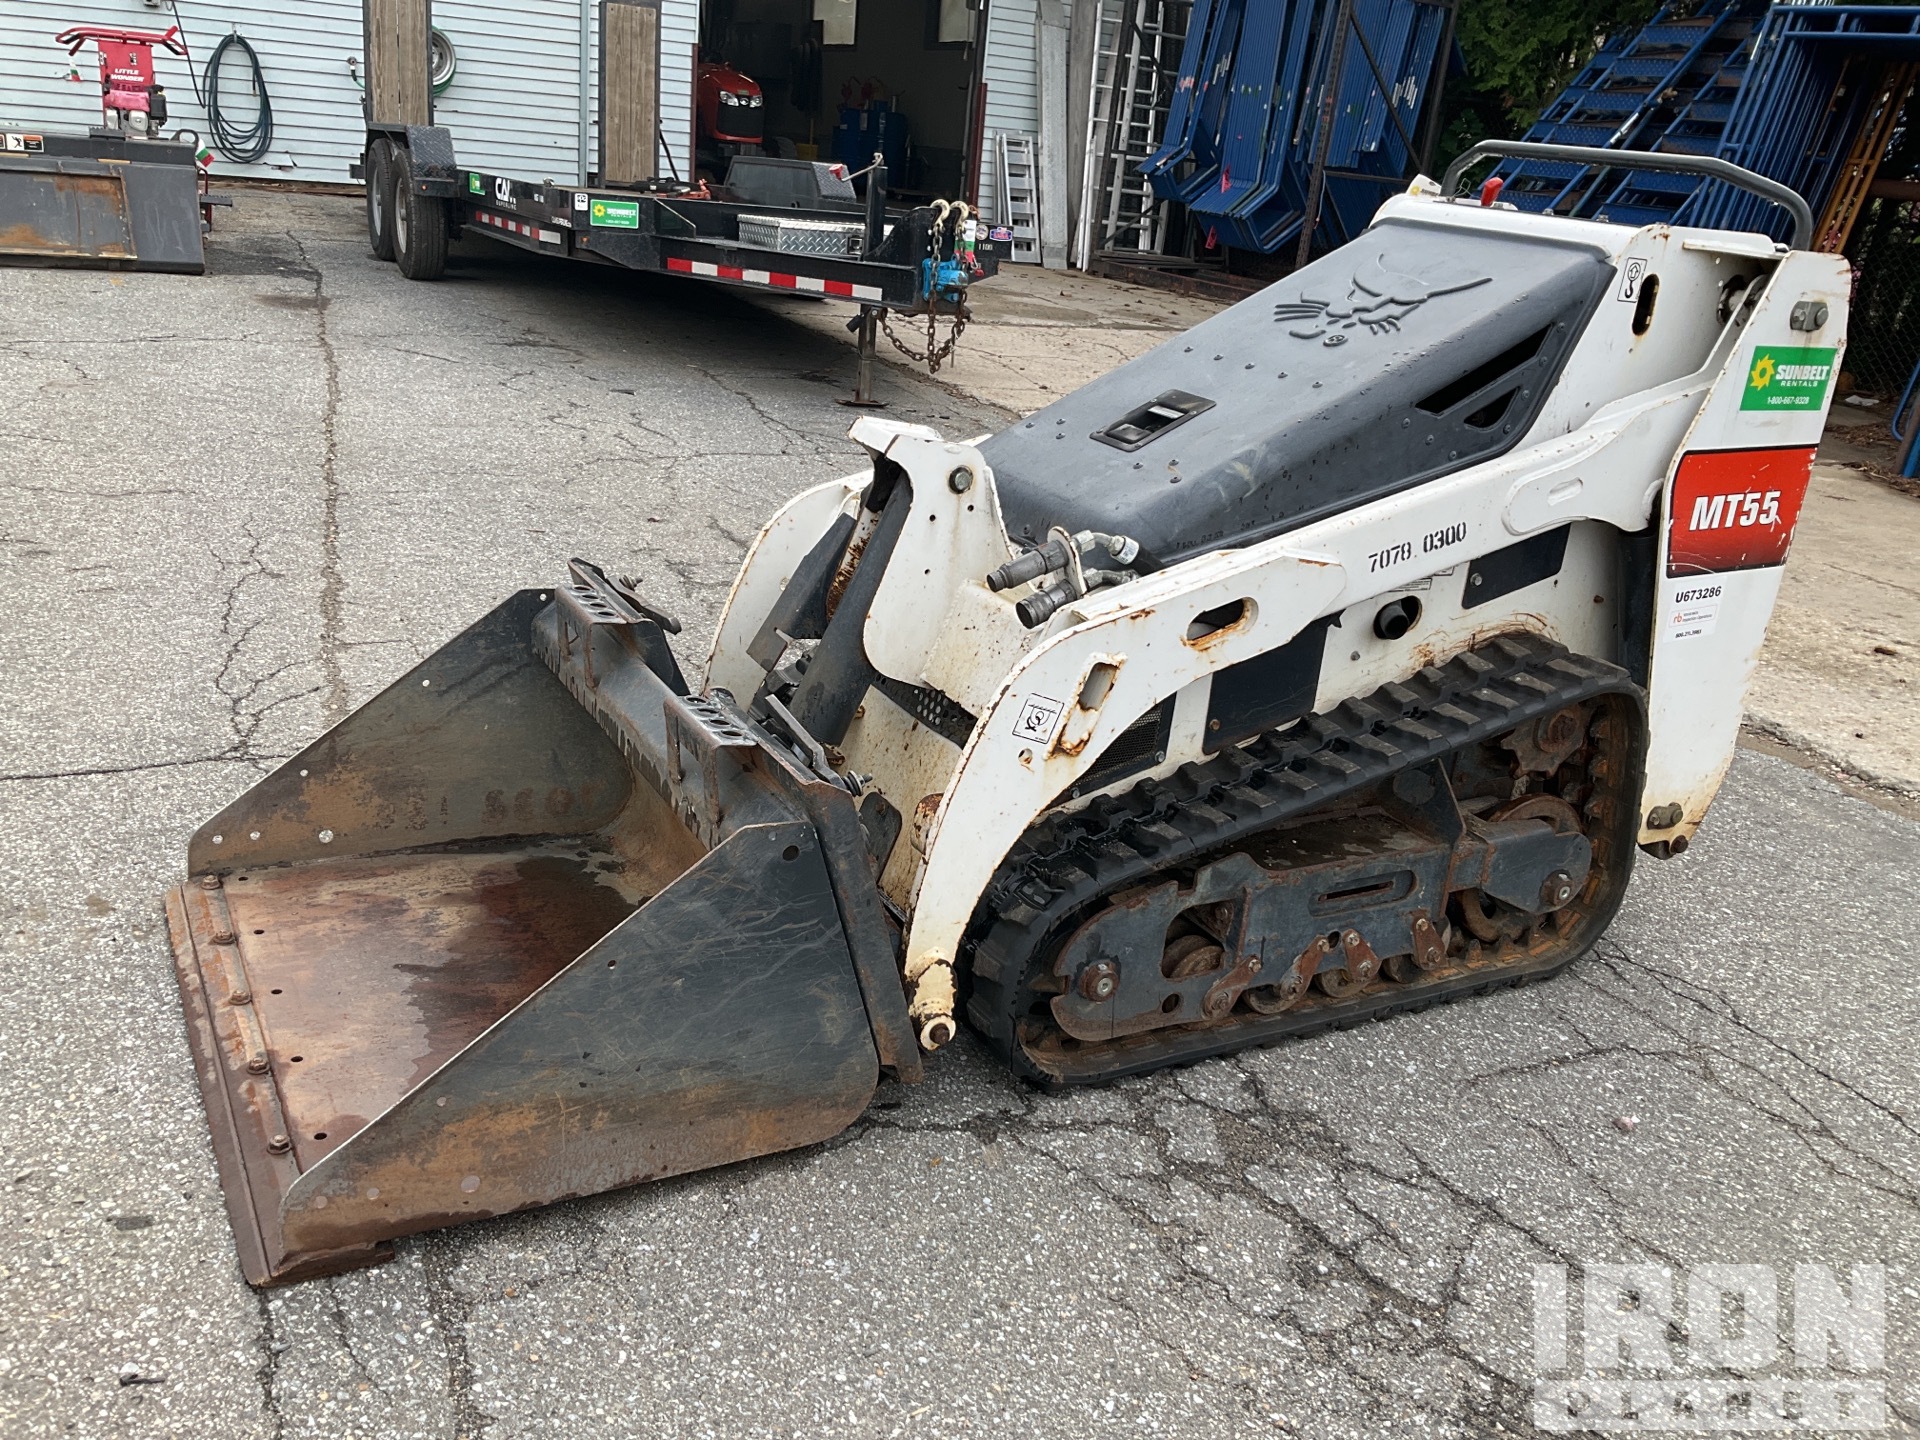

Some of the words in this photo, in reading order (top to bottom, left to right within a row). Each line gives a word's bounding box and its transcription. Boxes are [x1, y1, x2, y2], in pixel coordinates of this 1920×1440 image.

[111, 74, 144, 82] WONDER
[1776, 365, 1830, 380] SUNBELT
[1780, 380, 1819, 388] RENTALS
[1689, 491, 1781, 531] MT55
[1368, 541, 1412, 573] 7078
[1423, 521, 1467, 553] 0300
[1675, 585, 1722, 603] U673286
